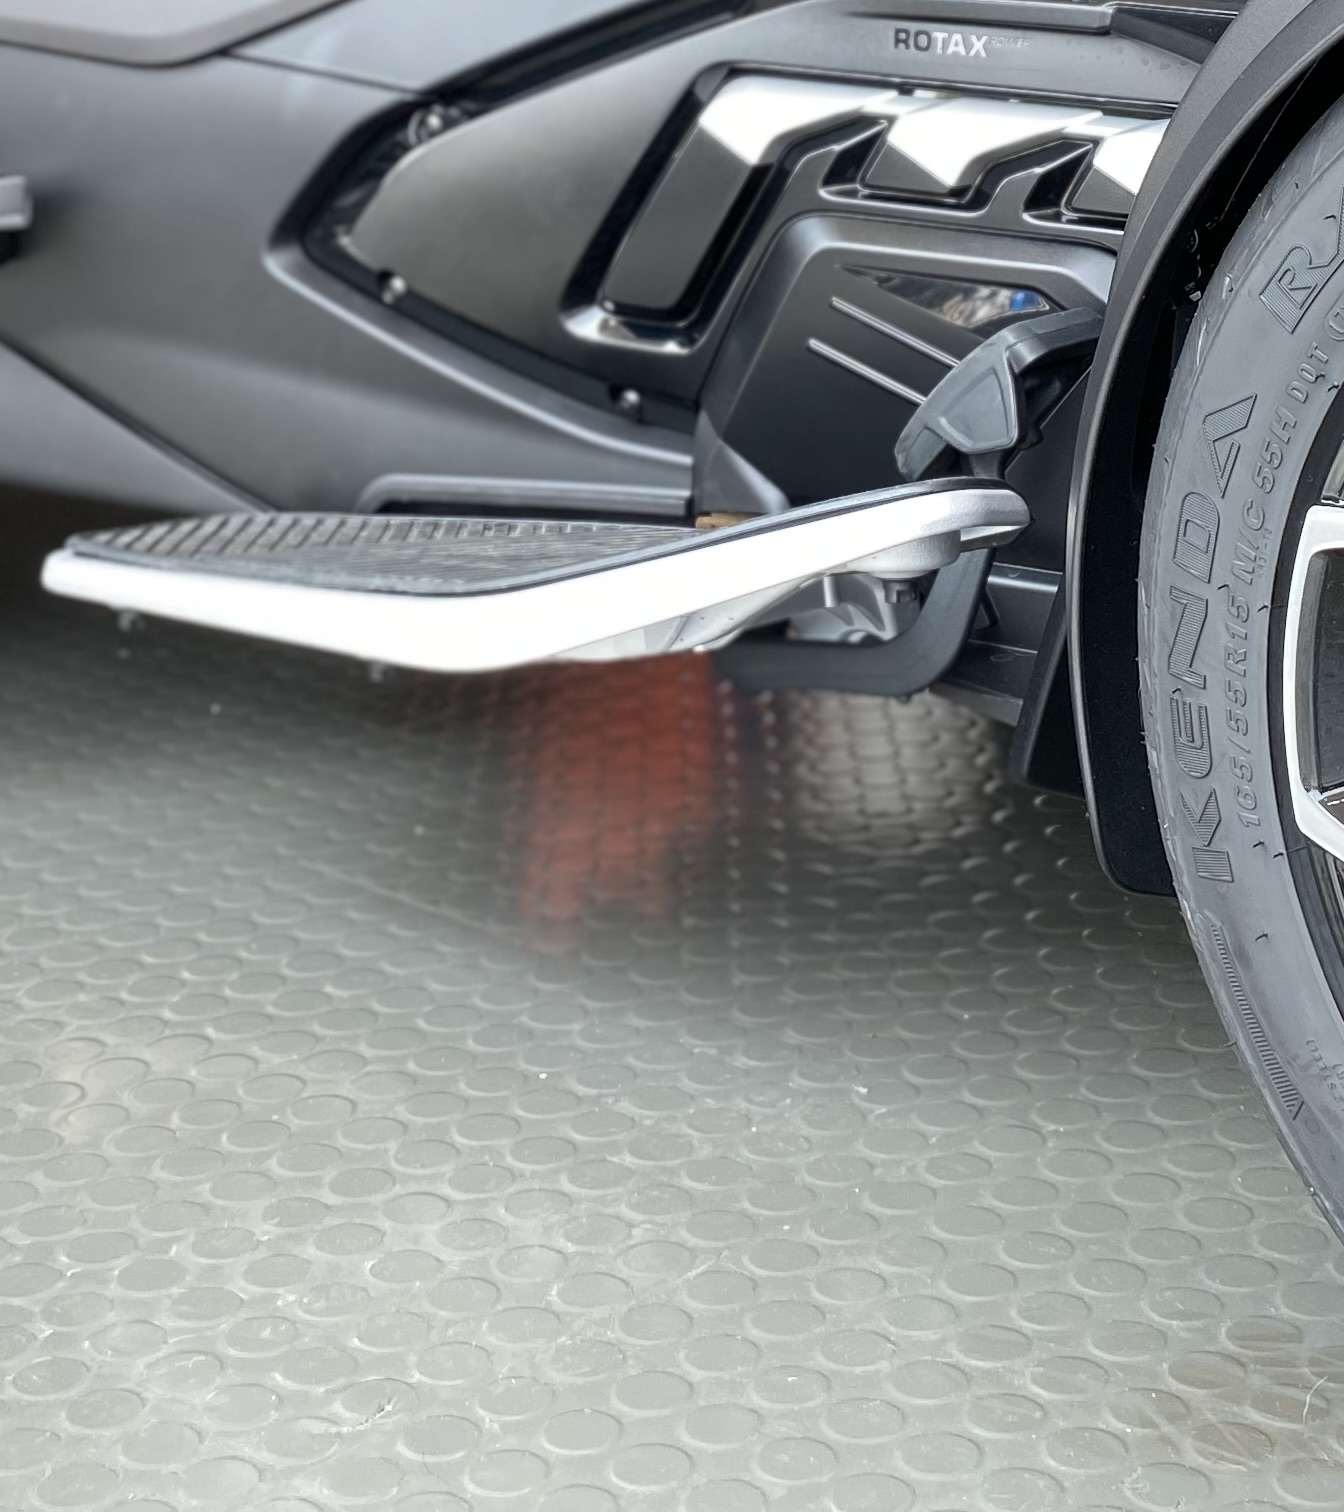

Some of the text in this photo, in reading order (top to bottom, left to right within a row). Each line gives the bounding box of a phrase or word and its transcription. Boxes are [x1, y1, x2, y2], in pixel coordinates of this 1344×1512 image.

[893, 27, 989, 59] ROTAX
[1255, 409, 1299, 496] 55H
[1230, 496, 1267, 588] M/C
[1168, 391, 1258, 883] KENDA
[1223, 591, 1260, 830] 165/55R15
